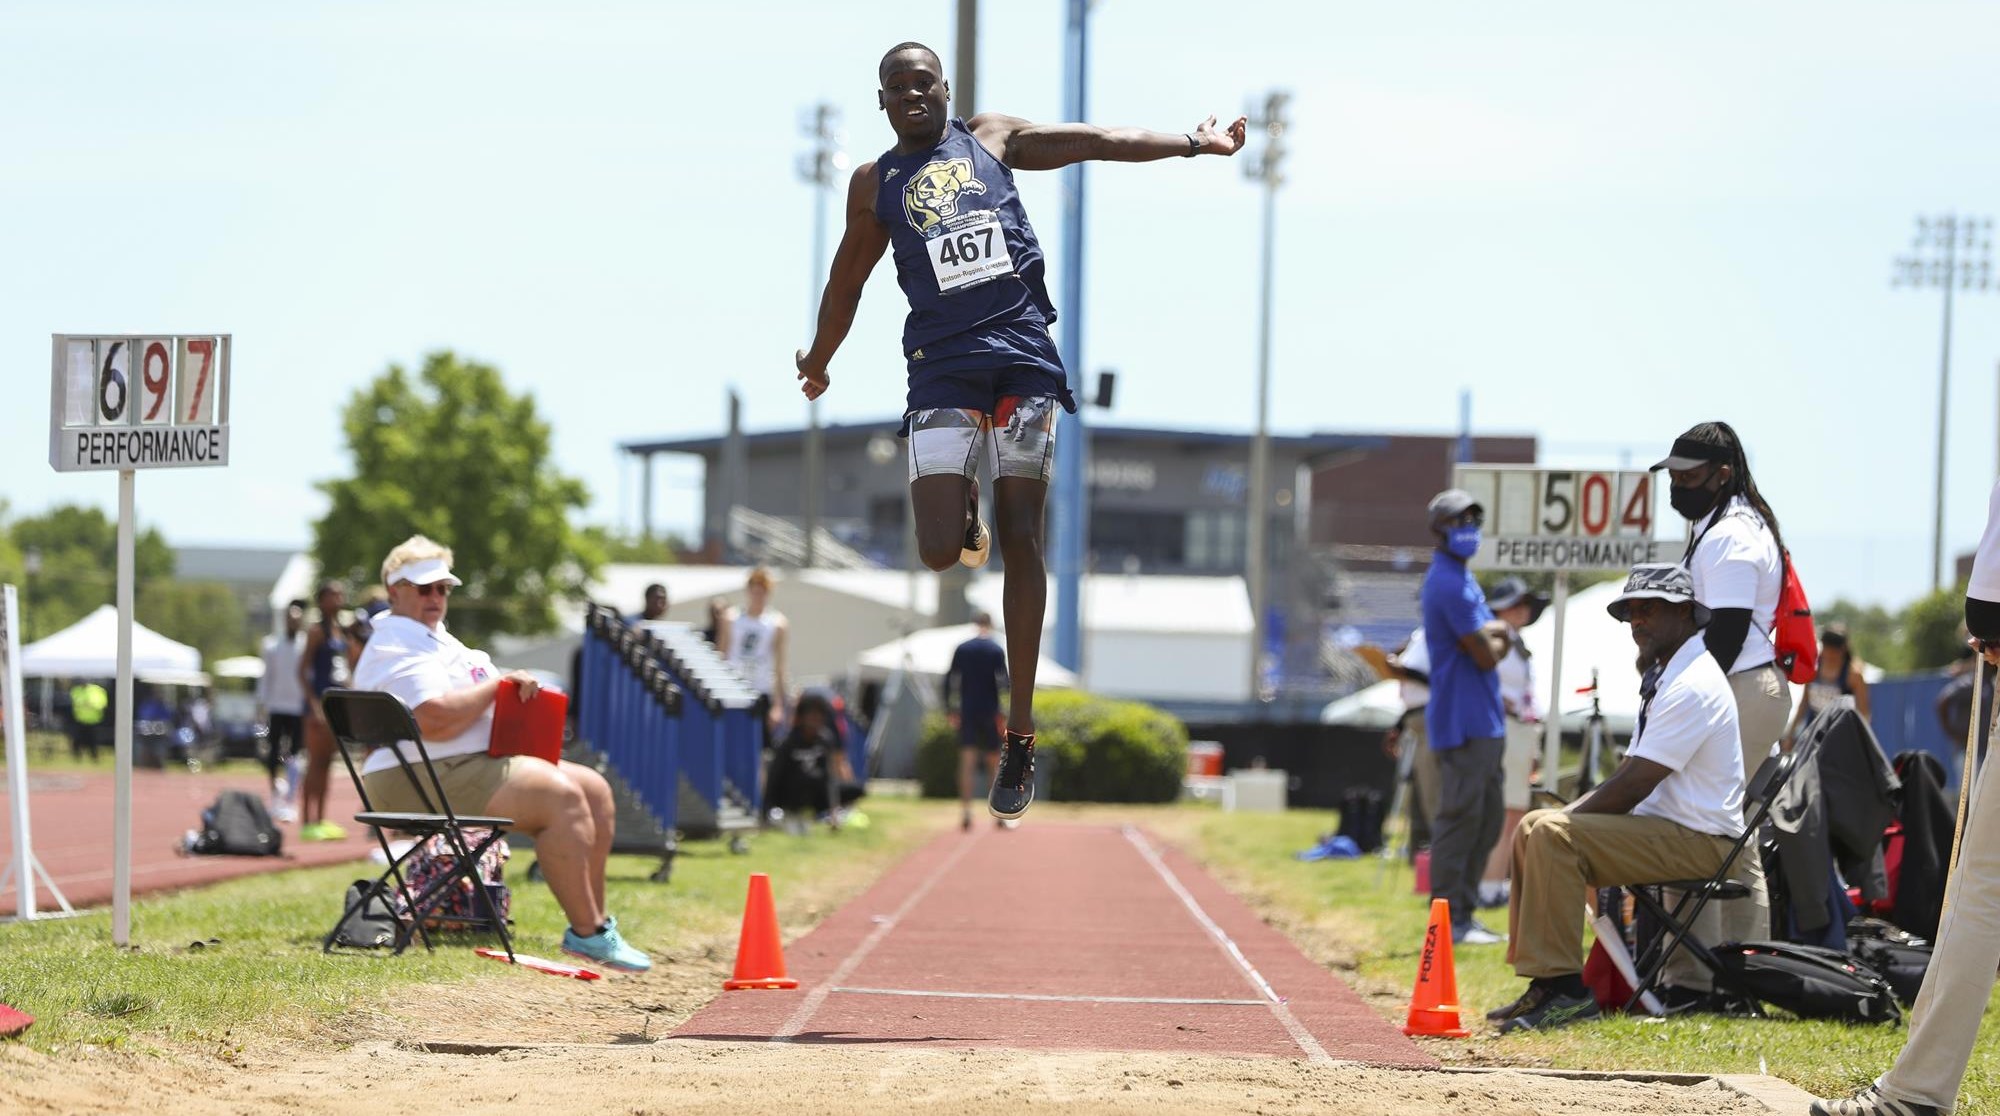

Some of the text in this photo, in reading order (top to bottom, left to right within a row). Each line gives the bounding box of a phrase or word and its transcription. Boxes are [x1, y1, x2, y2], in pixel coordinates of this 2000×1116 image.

[939, 227, 994, 267] 467
[77, 429, 220, 465] PERFORMANCE
[1497, 539, 1658, 566] PERFORMANCE
[1420, 924, 1438, 983] FORZA
